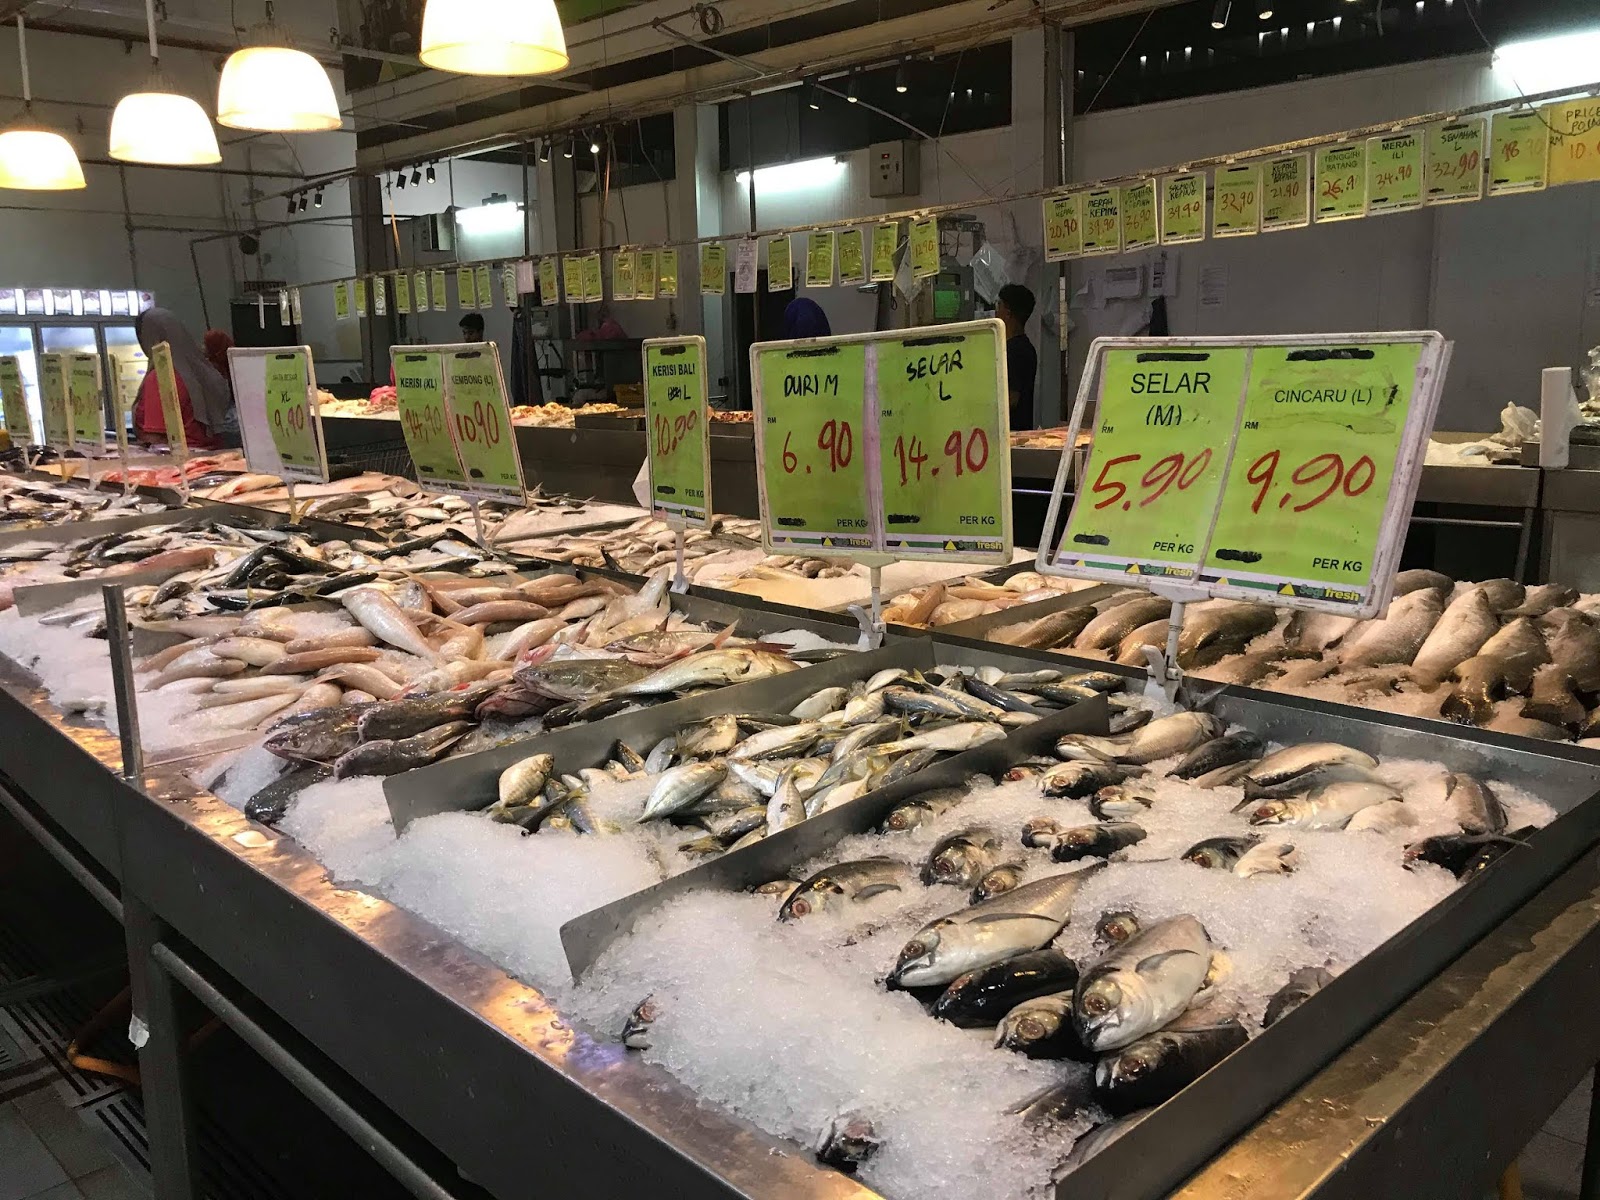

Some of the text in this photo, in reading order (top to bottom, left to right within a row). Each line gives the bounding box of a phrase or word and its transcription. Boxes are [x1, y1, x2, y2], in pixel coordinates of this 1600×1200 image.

[1381, 139, 1415, 151] MERAH
[1454, 141, 1462, 152] L
[1324, 151, 1361, 162] TENGGIRI
[1326, 160, 1358, 171] BATANG
[1375, 164, 1413, 190] 34.90
[1087, 198, 1113, 208] MERAH
[1089, 206, 1118, 218] KEPING
[652, 363, 695, 377] KERISI BALI
[906, 350, 963, 381] SELAR
[400, 378, 438, 391] KERISI (XL)
[451, 375, 483, 385] KEMBONG
[784, 374, 839, 397] DURI M
[1130, 372, 1211, 394] SELAR
[281, 391, 291, 403] XL
[683, 384, 691, 400] L
[938, 381, 952, 401] L
[1274, 389, 1373, 405] CINCARU (L)
[881, 409, 892, 417] RM
[1145, 405, 1183, 426] (M)
[767, 416, 777, 424] RM
[1244, 421, 1259, 430] RM
[1101, 425, 1114, 434] RM
[782, 418, 853, 474] 6.90
[893, 427, 989, 487] 14.90
[1091, 448, 1213, 512] 5.90
[685, 488, 704, 498] PER KG
[837, 518, 868, 528] PER KG
[959, 515, 996, 526] PER KG
[1153, 541, 1195, 554] PER KG
[1312, 557, 1363, 572] PER KG
[1325, 586, 1360, 602] fresh
